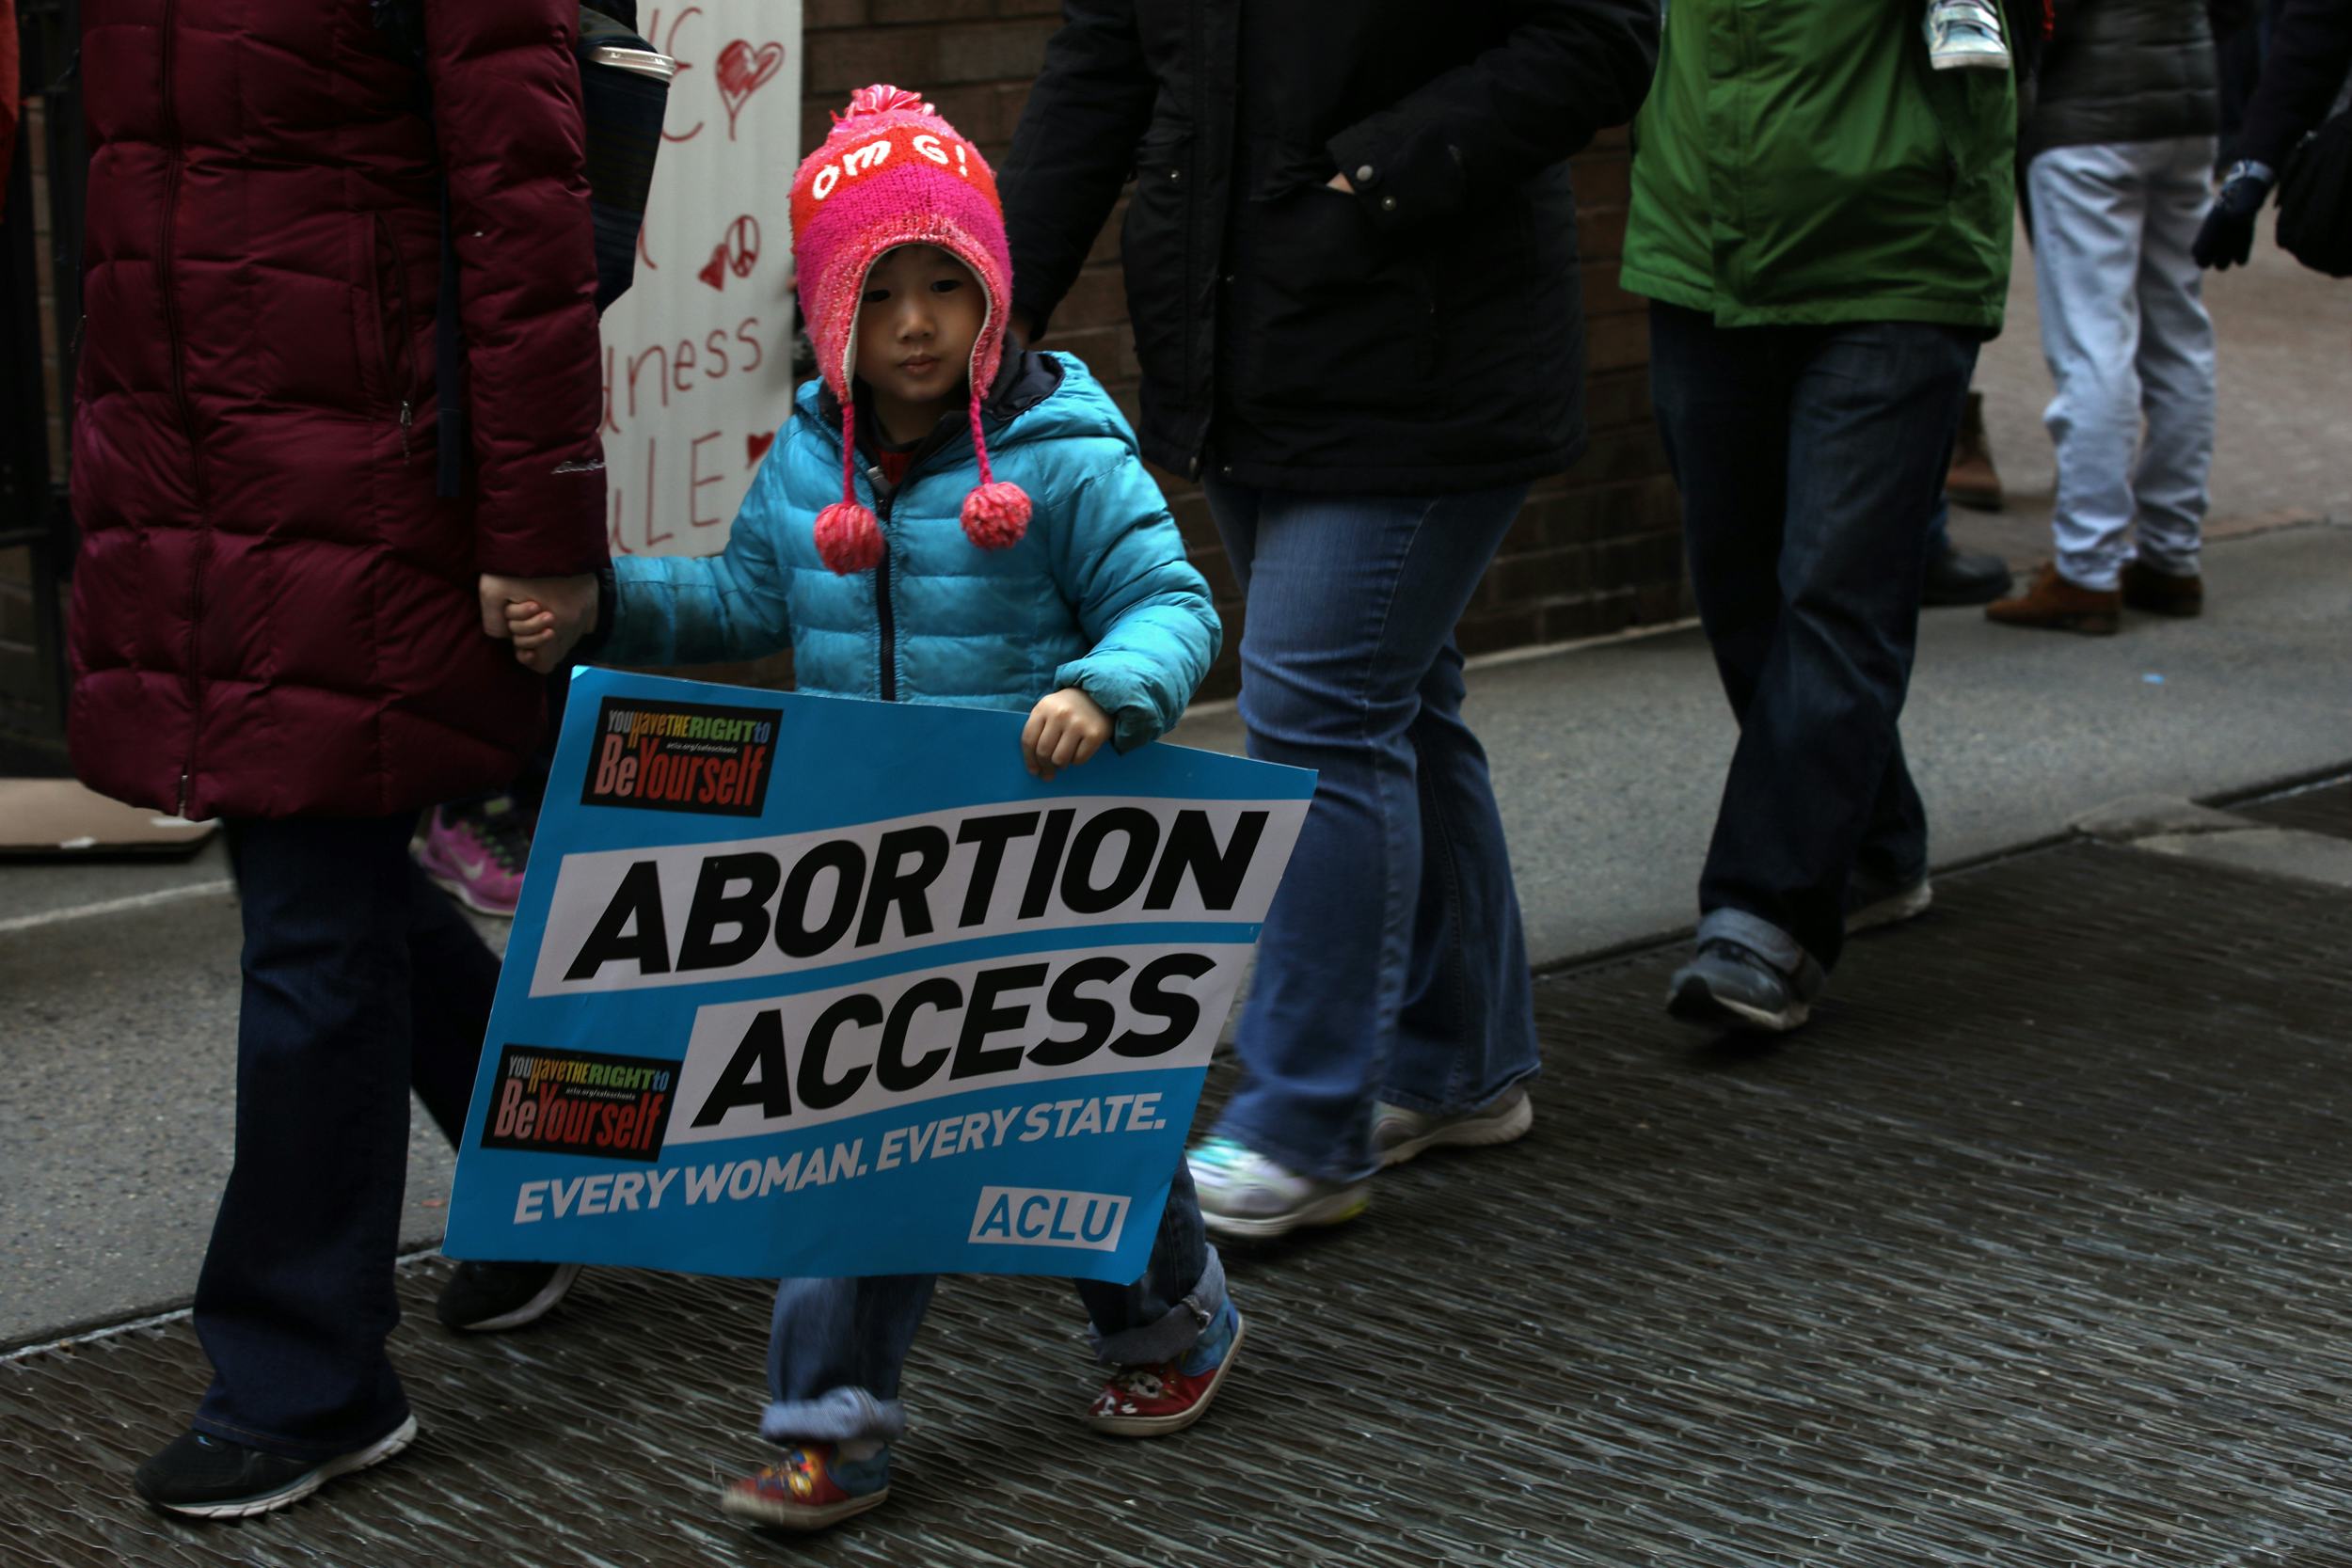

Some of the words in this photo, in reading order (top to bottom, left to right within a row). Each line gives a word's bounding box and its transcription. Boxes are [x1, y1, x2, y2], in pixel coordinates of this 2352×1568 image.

[562, 806, 1270, 982] ABORTION
[689, 952, 1217, 1129] ACCESS
[513, 1166, 681, 1225] EVERY
[684, 1136, 868, 1206] WOMAN.
[875, 1105, 1024, 1173] EVERY
[1017, 1091, 1168, 1143] STATE.
[976, 1193, 1120, 1243] ACLU
